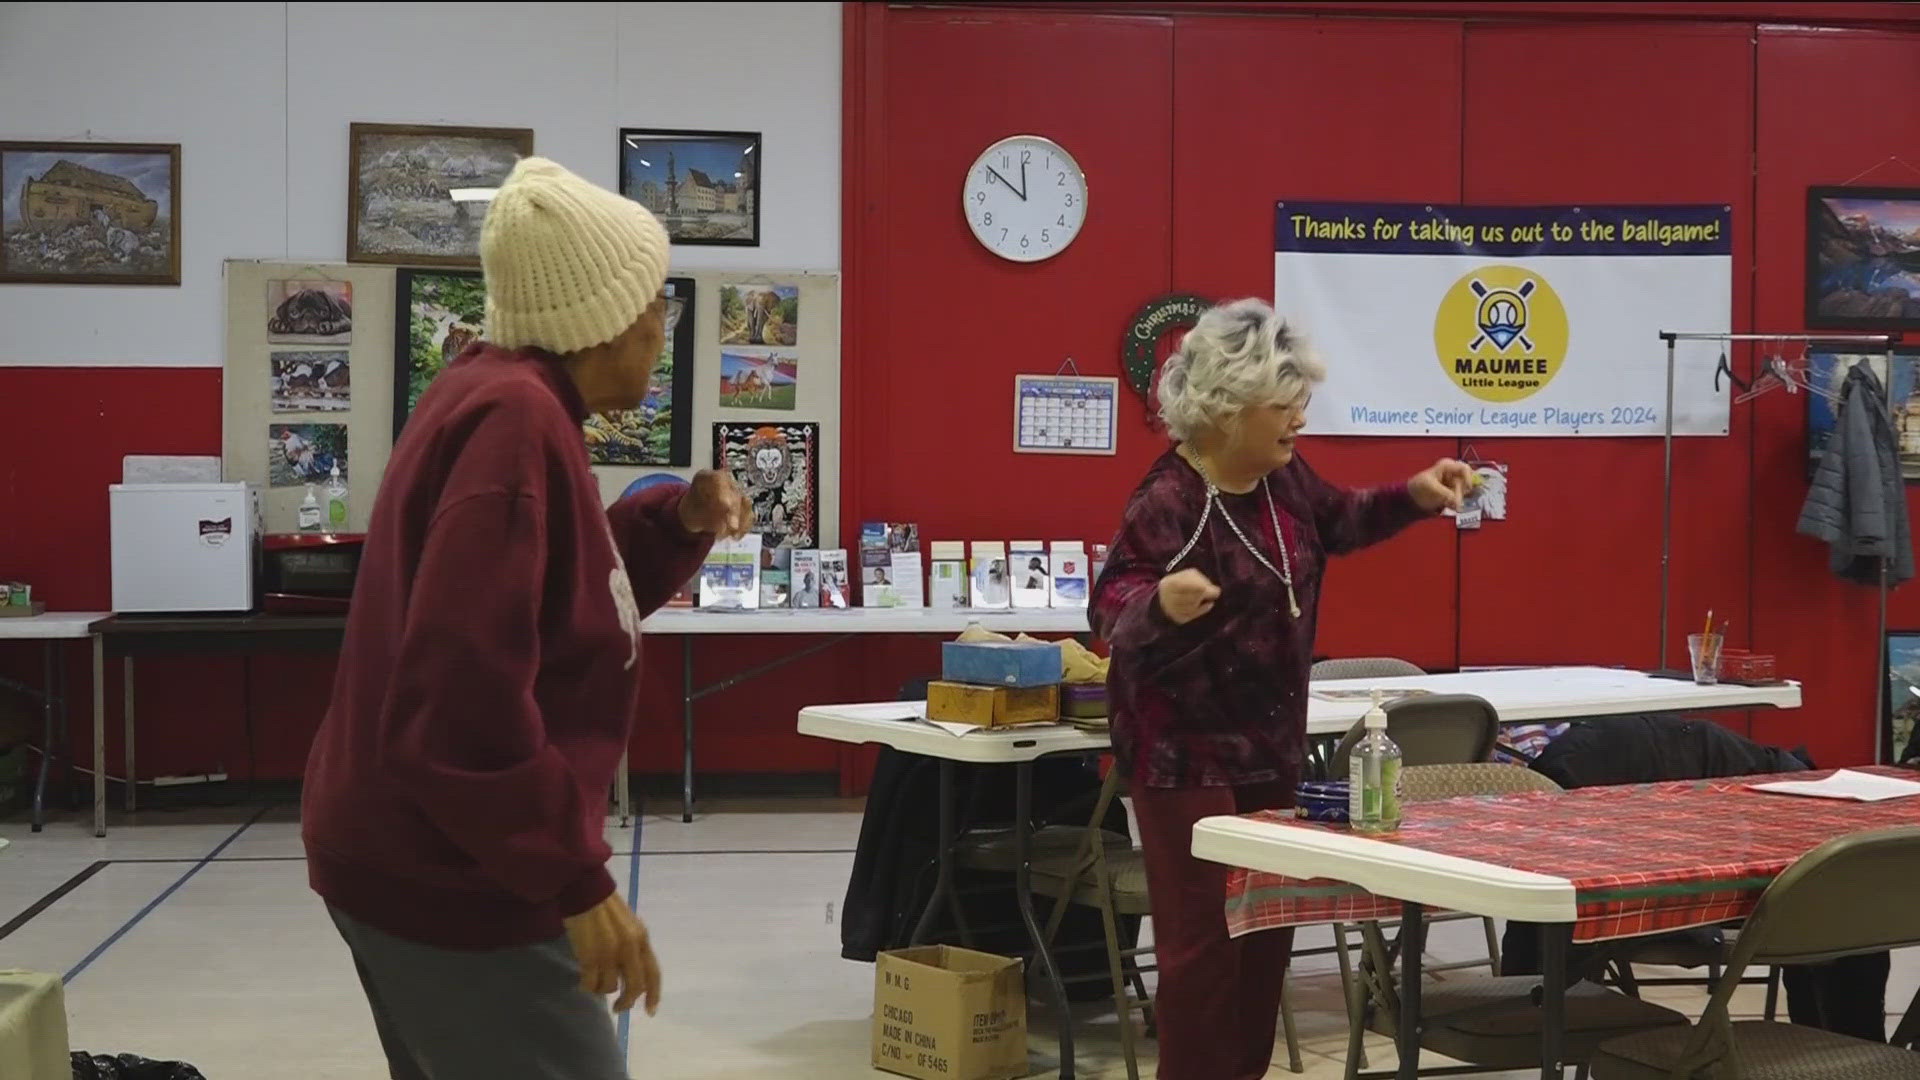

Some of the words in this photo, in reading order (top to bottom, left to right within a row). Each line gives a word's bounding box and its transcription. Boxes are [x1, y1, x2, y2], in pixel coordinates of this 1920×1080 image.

[1003, 155, 1009, 169] 11
[1020, 150, 1031, 164] 12
[985, 171, 996, 184] 10
[1057, 172, 1066, 186] 2
[977, 191, 986, 205] 9
[1064, 193, 1073, 207] 3
[983, 212, 992, 226] 8
[1057, 214, 1065, 227] 4
[1001, 228, 1008, 242] 7
[1041, 229, 1050, 243] 5
[1290, 215, 1366, 240] Thanks
[1372, 218, 1402, 240] for
[1408, 218, 1475, 246] taking
[1481, 225, 1505, 242] us
[1511, 222, 1545, 243] out
[1551, 221, 1573, 242] to
[1580, 219, 1615, 242] the
[1622, 219, 1720, 246] ballgame!
[1020, 235, 1029, 248] 6
[1134, 303, 1196, 340] CHRISTMAS
[1455, 358, 1548, 374] MAUMEE
[1462, 378, 1494, 387] Little
[1498, 378, 1540, 389] League
[1351, 406, 1419, 424] Maumee
[1424, 407, 1475, 425] Senior
[1480, 407, 1537, 428] League
[1544, 407, 1604, 429] Players
[1611, 406, 1658, 425] 2024
[883, 1004, 913, 1025] CHICAGO
[883, 1024, 902, 1042] MADE
[904, 1030, 913, 1044] IN
[915, 1032, 936, 1051] CHINA
